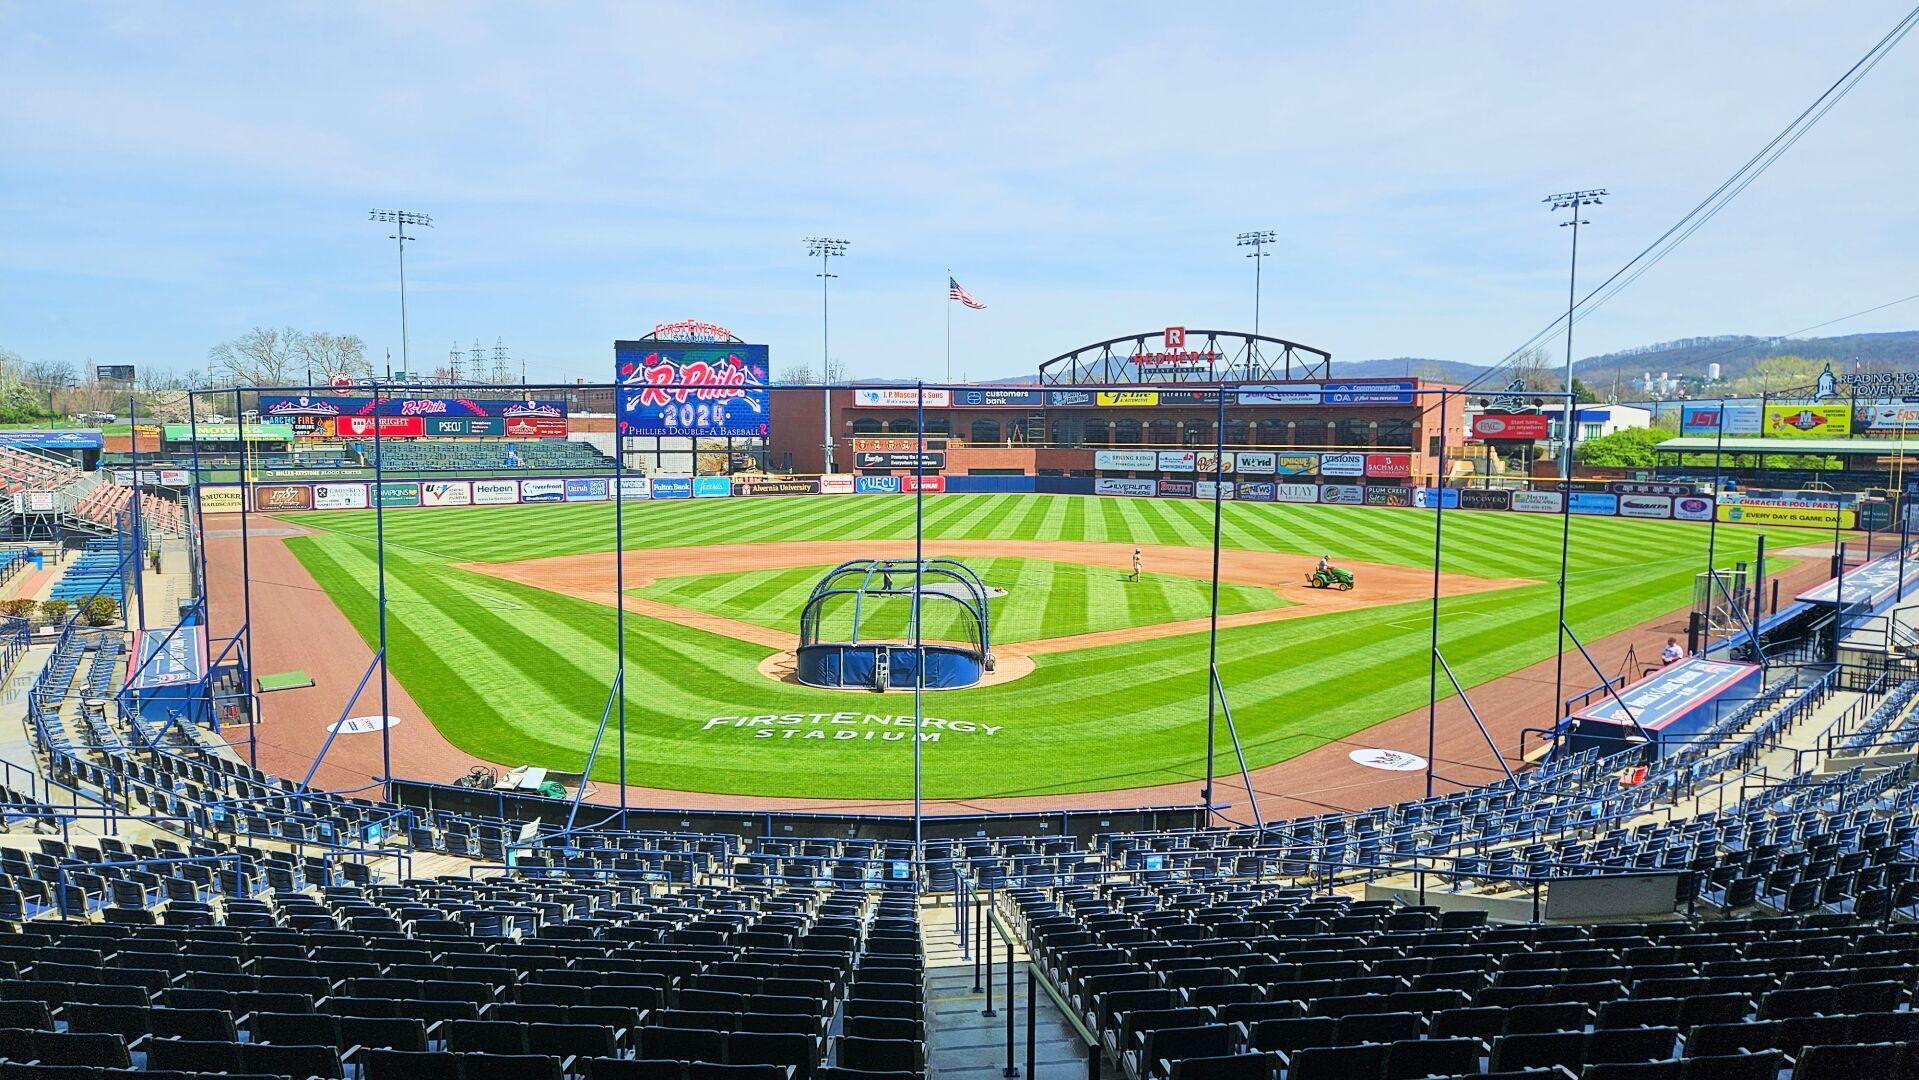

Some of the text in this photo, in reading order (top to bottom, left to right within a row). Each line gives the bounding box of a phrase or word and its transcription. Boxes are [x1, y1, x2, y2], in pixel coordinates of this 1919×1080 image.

[655, 319, 731, 340] FIRSTENERGY
[672, 334, 715, 343] STADIUM
[1169, 329, 1181, 345] R
[1841, 374, 1893, 384] READING
[894, 391, 921, 399] Mascar
[927, 391, 944, 399] Sons
[1852, 385, 1895, 395] TOWER
[664, 403, 724, 426] 2024
[269, 416, 315, 425] ARCTIC FIRE
[365, 418, 409, 426] ALRIGHT
[438, 421, 462, 432] PSECU
[629, 426, 760, 436] PHILLIES DOUBLE-A BASEBALL
[1325, 455, 1360, 464] VISIONS
[752, 484, 779, 492] Alvernia
[780, 483, 812, 492] University
[867, 477, 896, 488] UECU
[1100, 480, 1152, 491] SILVERLINE
[270, 487, 299, 501] 1787
[371, 488, 409, 496] TMPKINS
[477, 485, 513, 493] Herbein
[1249, 485, 1270, 493] NEWS
[1462, 495, 1507, 503] DISCOVERY
[1739, 498, 1787, 507] CHARACTER
[1789, 500, 1810, 508] POOL
[1745, 512, 1771, 520] EVERY
[702, 712, 1004, 735] FIRSTENERGY
[754, 729, 941, 742] STADIUM
